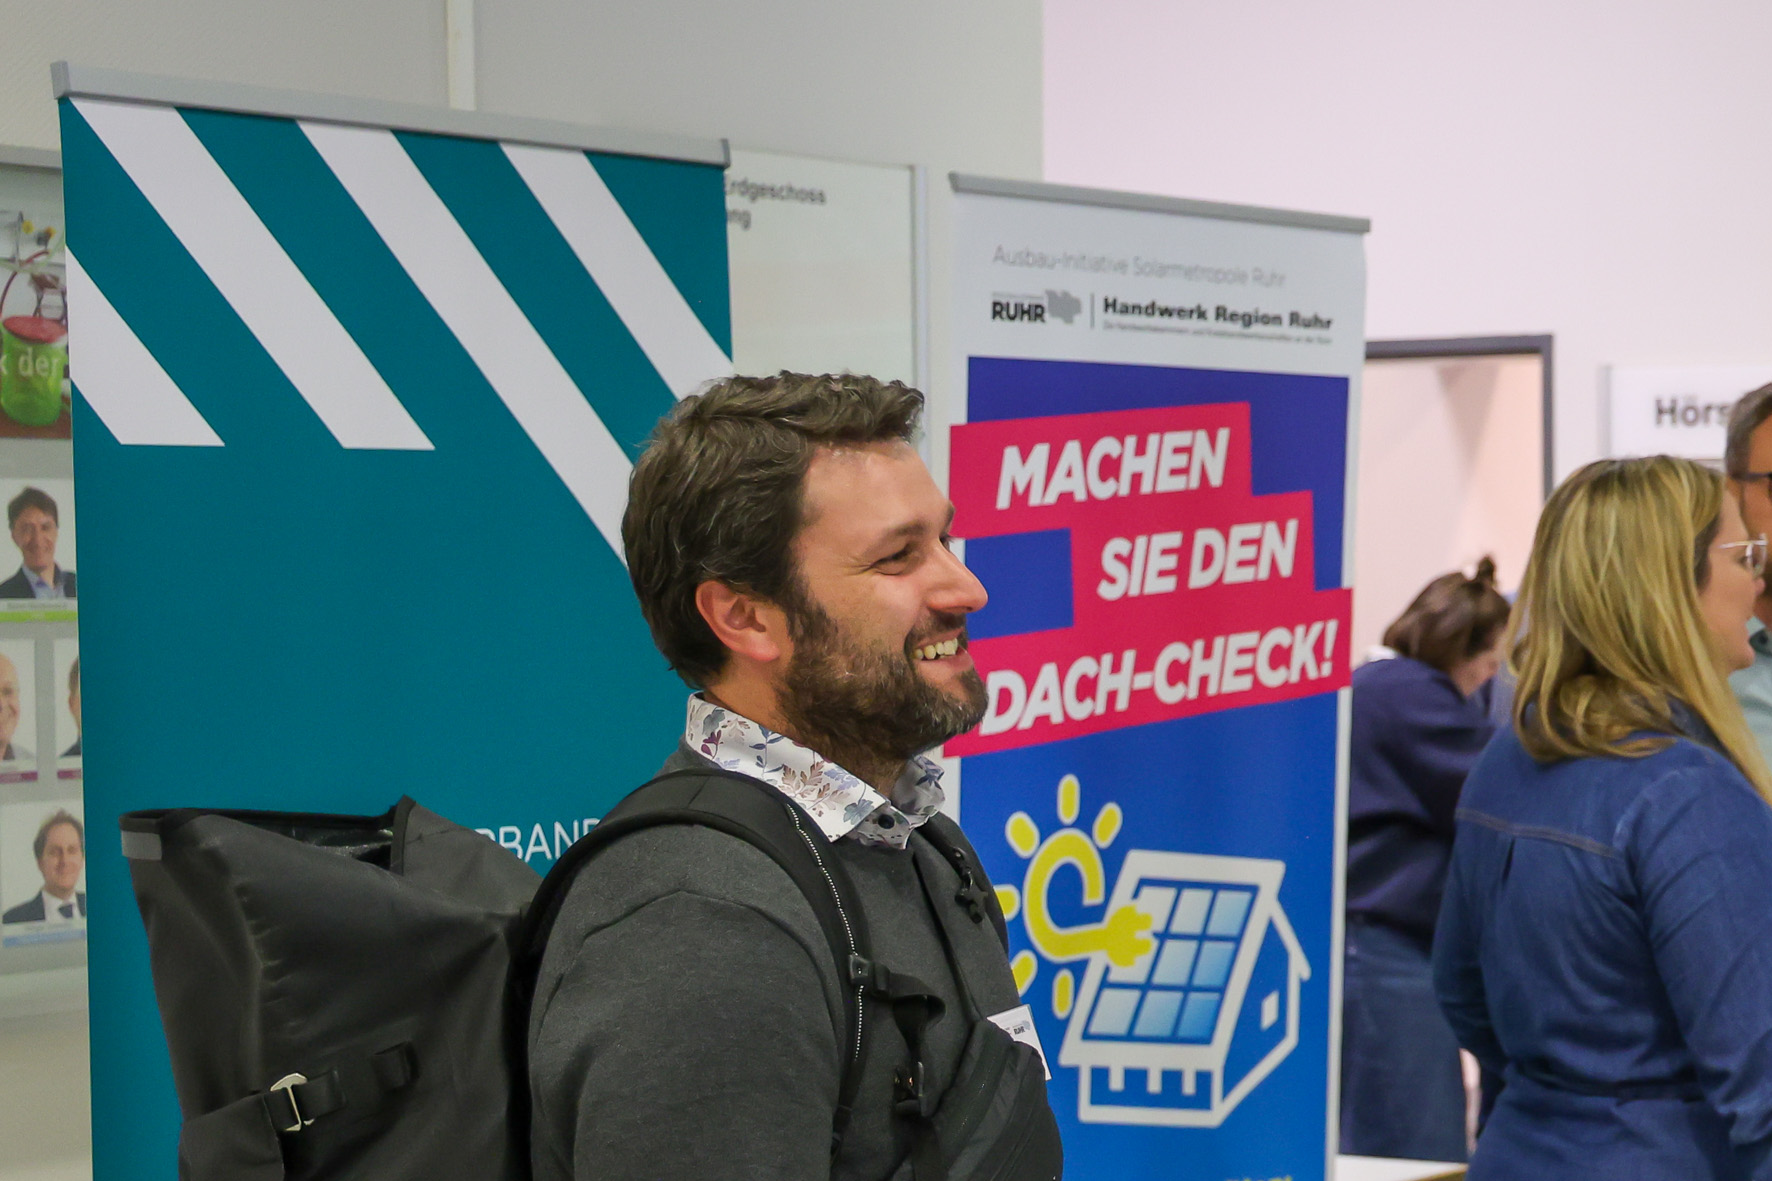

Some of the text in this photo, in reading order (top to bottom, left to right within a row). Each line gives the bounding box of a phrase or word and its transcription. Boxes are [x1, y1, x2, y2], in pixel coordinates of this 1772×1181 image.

[991, 300, 1046, 323] RUHR
[1102, 296, 1333, 330] Handwerk Region Ruhr
[996, 427, 1231, 511] MACHEN
[1097, 518, 1300, 601] SIE DEN
[979, 619, 1340, 737] DACH-CHECK!
